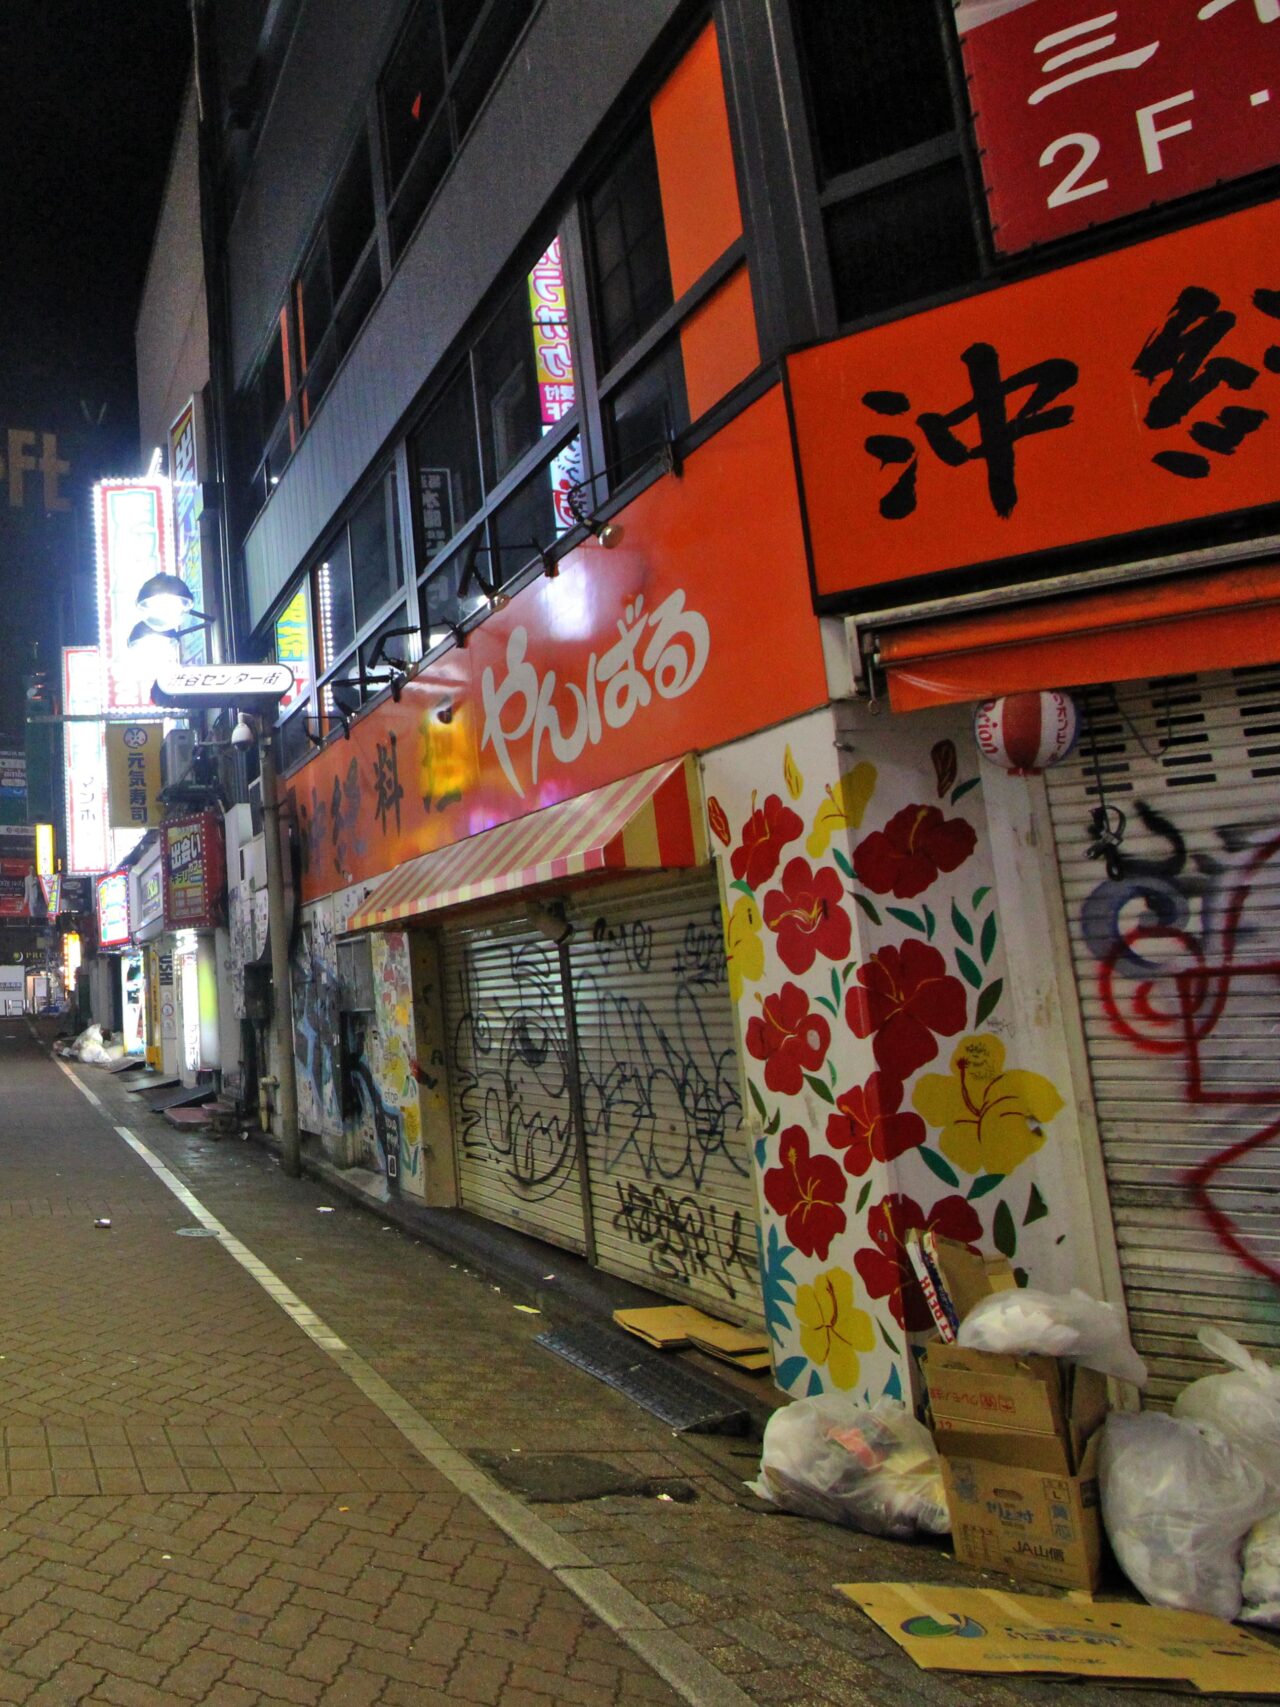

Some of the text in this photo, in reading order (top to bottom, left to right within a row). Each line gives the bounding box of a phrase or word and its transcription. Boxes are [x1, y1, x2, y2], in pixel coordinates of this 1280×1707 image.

[480, 587, 711, 799] やんばる
[127, 752, 149, 824] 元気寿司
[171, 832, 201, 869] 出会い
[158, 948, 174, 986] USHI
